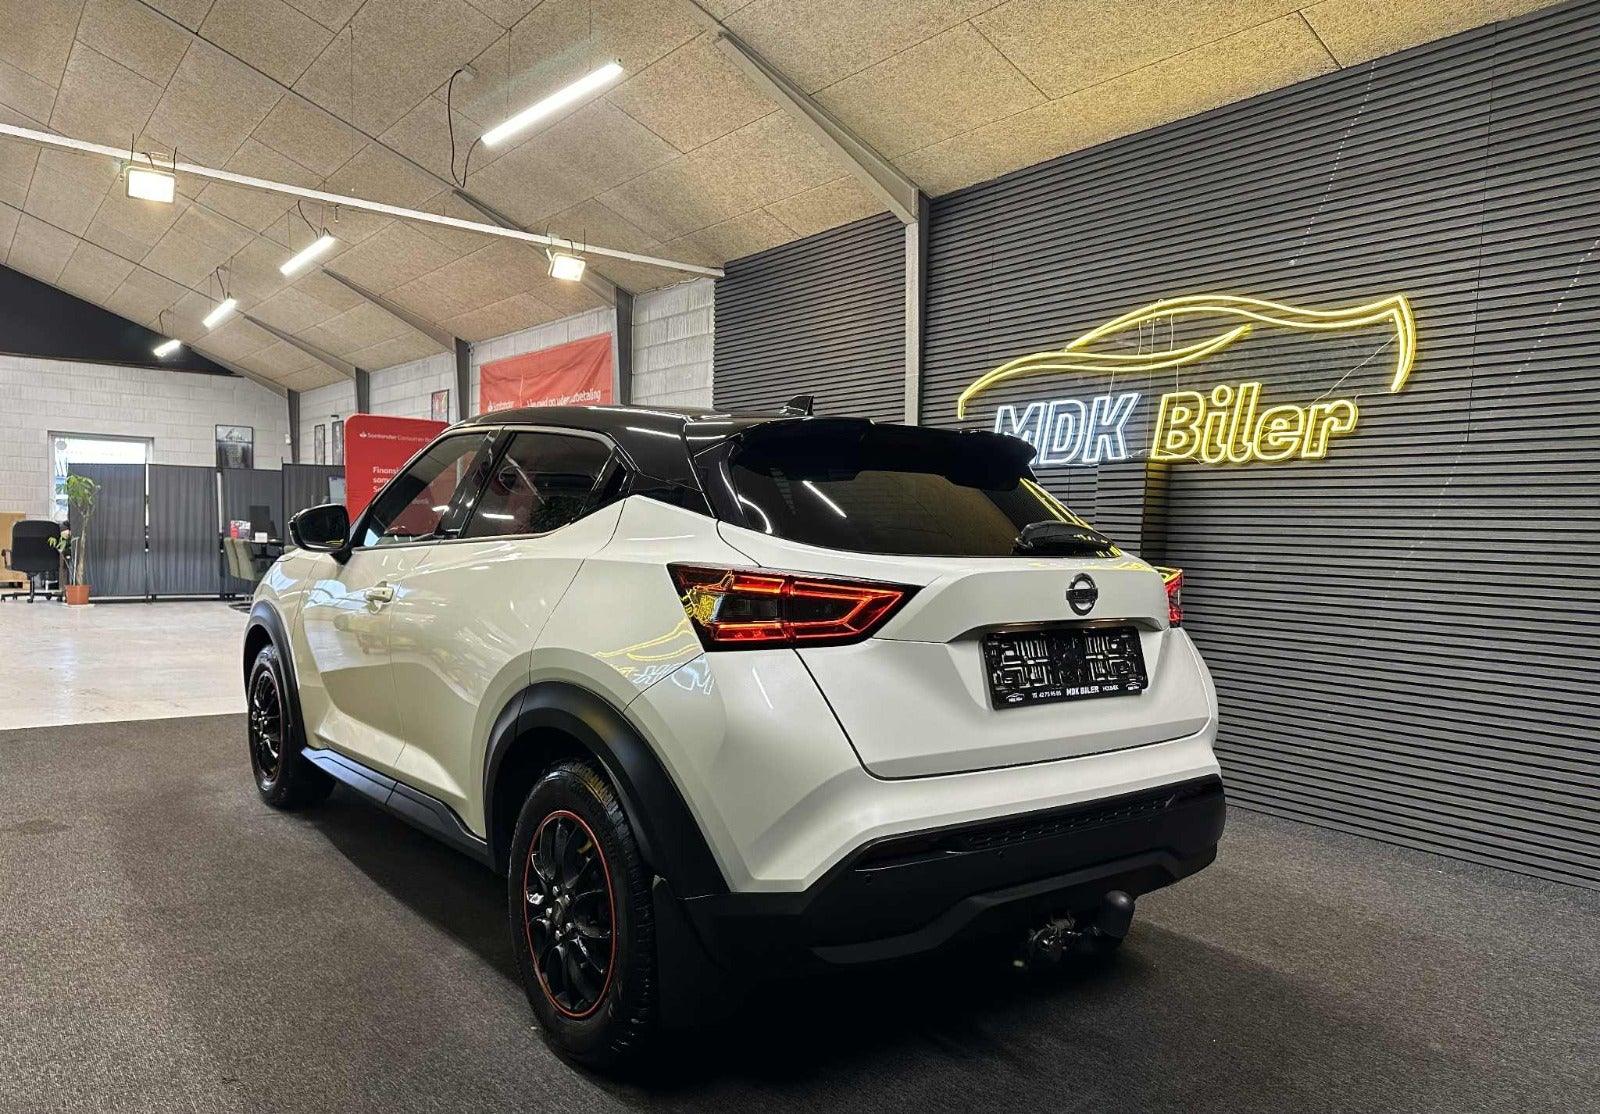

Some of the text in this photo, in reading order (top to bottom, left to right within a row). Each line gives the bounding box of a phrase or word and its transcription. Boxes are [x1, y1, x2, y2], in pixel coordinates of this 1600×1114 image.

[367, 432, 397, 440] Santander
[995, 382, 1359, 464] MDK Biler
